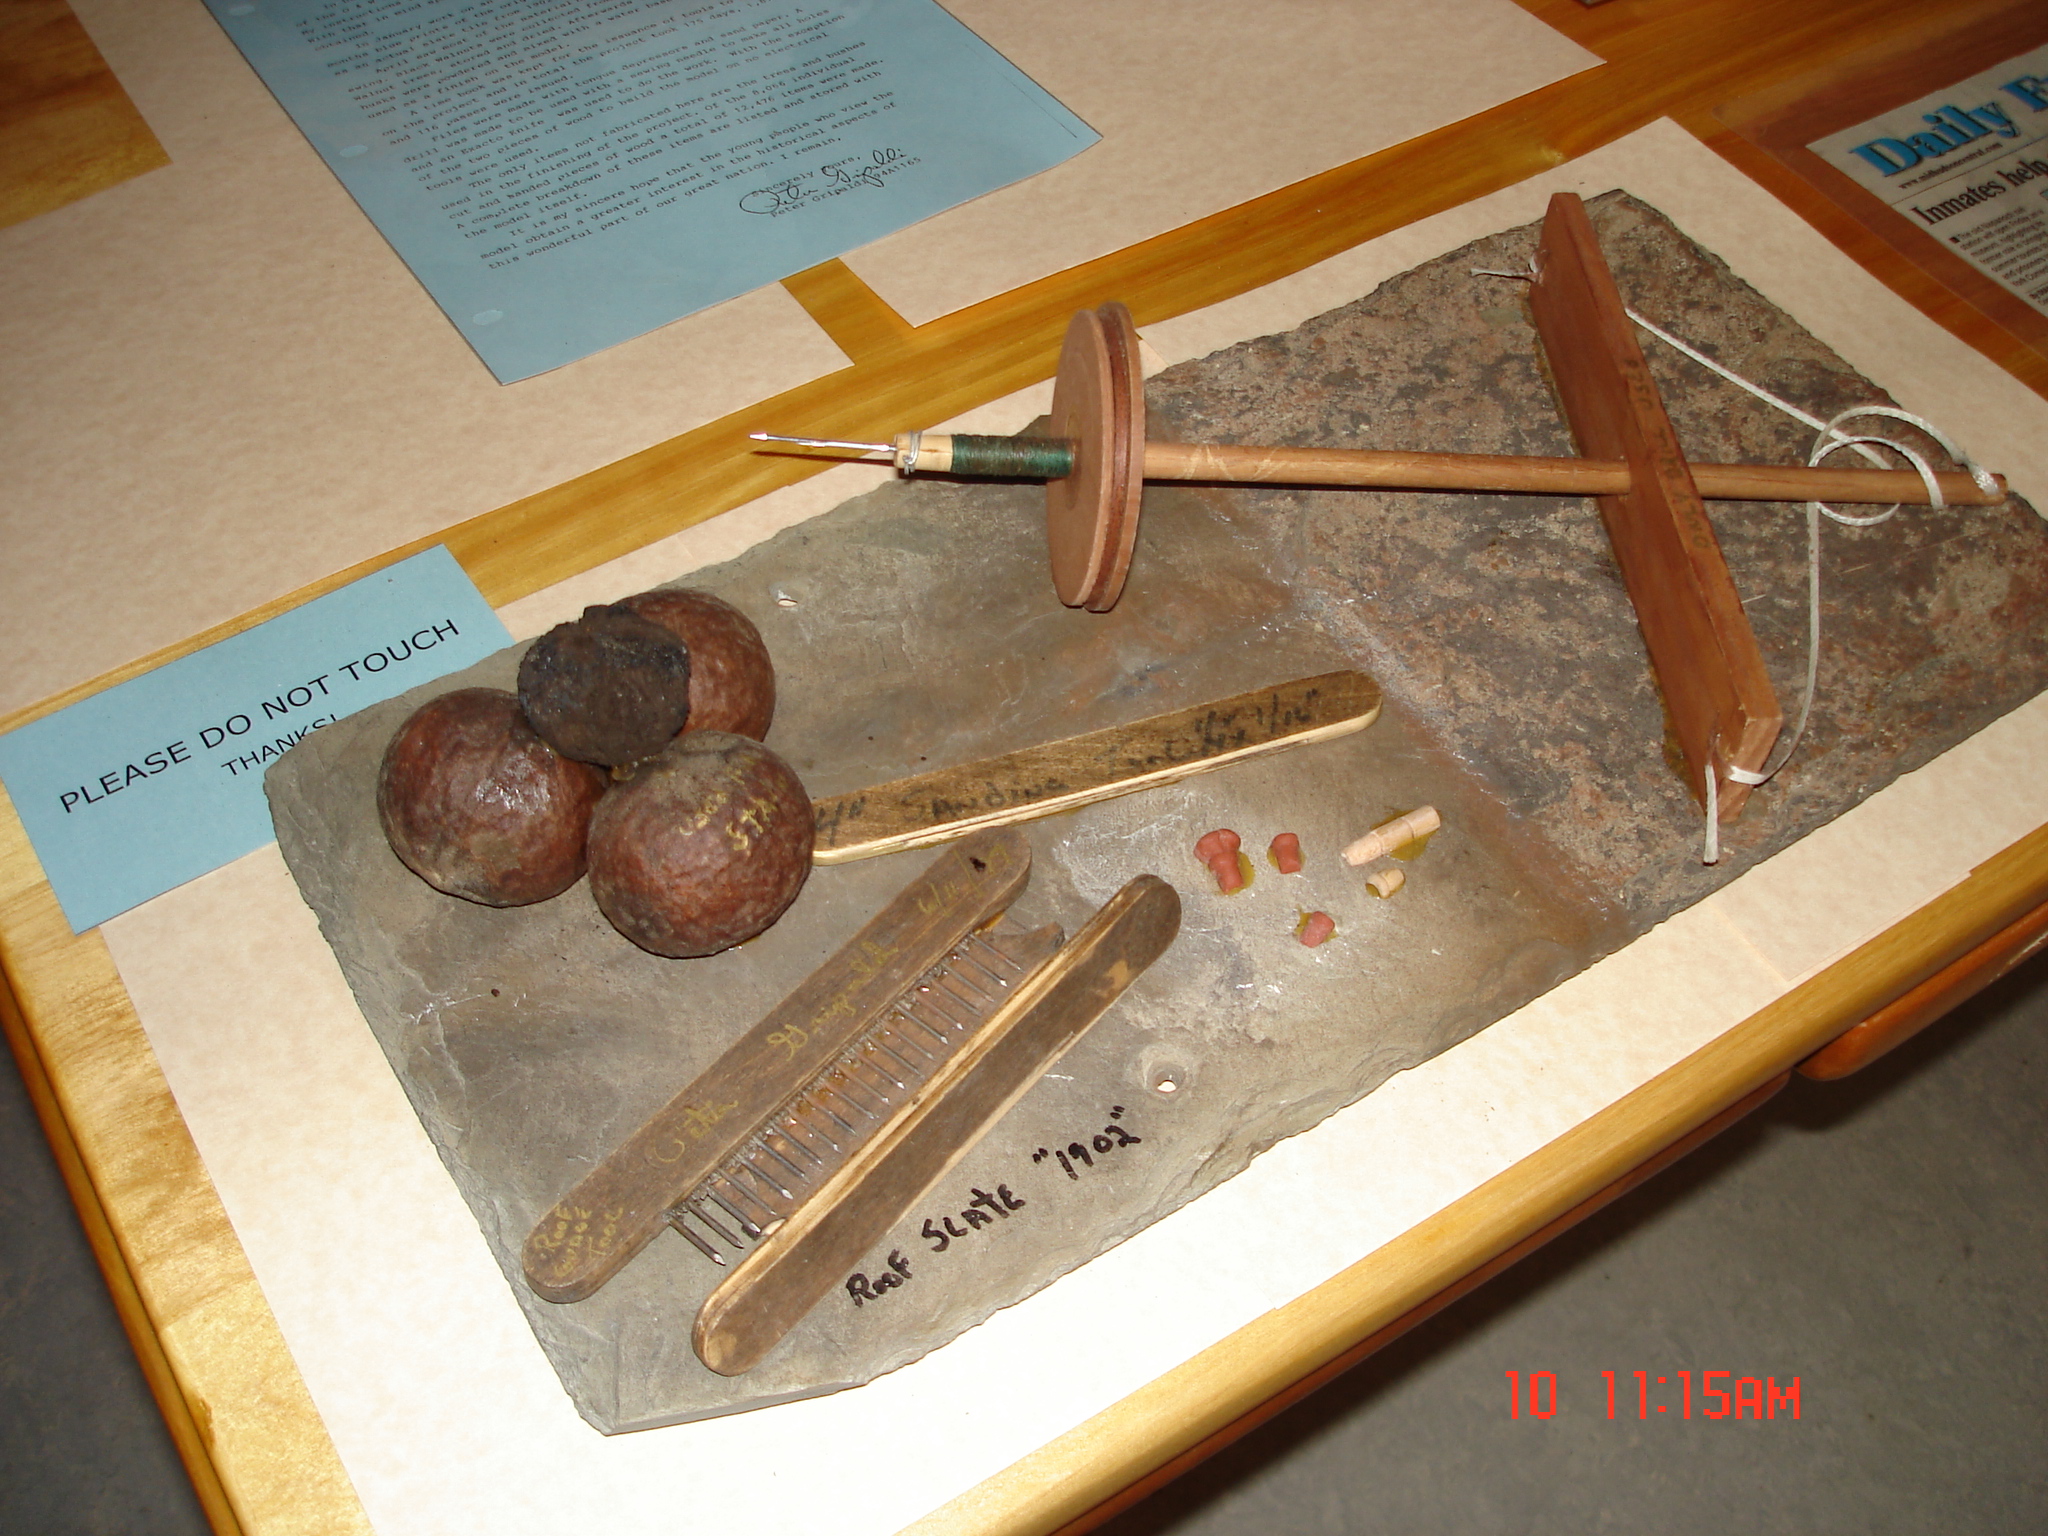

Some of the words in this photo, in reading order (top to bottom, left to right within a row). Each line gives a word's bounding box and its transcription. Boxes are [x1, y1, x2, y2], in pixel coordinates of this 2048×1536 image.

[410, 160, 434, 173] and
[439, 154, 455, 163] an
[556, 106, 579, 117] was
[583, 92, 613, 107] used
[616, 86, 633, 94] to
[637, 79, 653, 88] do
[656, 70, 679, 80] the
[683, 59, 717, 72] work.
[728, 45, 758, 57] With
[761, 36, 782, 46] the
[787, 14, 846, 38] exception
[417, 172, 432, 182] of
[439, 162, 462, 175] the
[467, 152, 491, 164] two
[496, 133, 540, 154] pieces
[544, 124, 559, 135] of
[564, 111, 594, 126] wood
[598, 105, 614, 113] to
[658, 80, 681, 91] the
[685, 67, 719, 83] model
[725, 61, 741, 69] on
[744, 55, 760, 63] no
[763, 31, 830, 57] electrical
[440, 195, 472, 210] used
[478, 189, 494, 198] in
[498, 178, 521, 190] the
[526, 150, 592, 180] finishing
[596, 141, 611, 152] of
[616, 132, 640, 144] the
[645, 111, 699, 134] project.
[703, 101, 720, 111] Of
[724, 94, 747, 104] the
[791, 56, 856, 83] individual
[448, 208, 472, 220] cut
[478, 197, 502, 210] and
[557, 160, 600, 182] pieces
[604, 151, 619, 162] of
[624, 137, 655, 153] wood
[672, 118, 709, 135] total
[713, 110, 728, 120] of
[780, 83, 815, 98] items
[818, 72, 847, 84] were
[850, 59, 884, 74] made.
[467, 177, 492, 189] The
[497, 162, 526, 178] only
[533, 147, 569, 165] items
[574, 136, 597, 148] not
[601, 106, 672, 137] fabricated
[674, 96, 705, 110] here
[710, 87, 732, 98] are
[735, 79, 758, 89] the
[762, 65, 797, 81] trees
[801, 56, 822, 68] and
[825, 40, 866, 59] bushes
[470, 200, 531, 225] complete
[534, 172, 602, 202] breakdown
[606, 163, 622, 174] of
[626, 148, 663, 166] these
[668, 132, 704, 149] items
[708, 123, 731, 134] are
[735, 106, 779, 125] listed
[782, 97, 805, 110] and
[809, 81, 850, 100] stored
[853, 70, 882, 84] with
[508, 227, 525, 237] It
[532, 219, 547, 229] is
[552, 211, 568, 221] my
[574, 189, 626, 213] sincere
[628, 176, 660, 191] hope
[665, 162, 695, 177] that
[699, 151, 722, 163] the
[726, 137, 764, 154] young
[813, 111, 836, 123] who
[839, 99, 868, 113] view
[872, 91, 894, 102] the
[823, 156, 861, 173] ours,
[1849, 102, 2021, 177] Daily
[425, 175, 463, 191] tools
[468, 162, 499, 176] were
[503, 147, 539, 163] used.
[463, 228, 488, 239] the
[492, 211, 532, 230] model
[538, 192, 588, 214] itself.
[479, 242, 519, 260] model
[524, 224, 571, 244] obtain
[589, 196, 641, 221] greater
[647, 171, 704, 198] interest
[709, 164, 725, 173] in
[728, 154, 752, 165] the
[755, 127, 827, 156] historical
[830, 109, 878, 130] aspects
[882, 100, 897, 111] of
[487, 255, 520, 270] this
[525, 228, 594, 257] wonderful
[599, 215, 630, 232] part
[634, 205, 650, 217] of
[655, 195, 678, 208] our
[683, 178, 720, 198] great
[724, 160, 774, 180] nation.
[1910, 180, 2007, 226] Inmates
[60, 741, 192, 813] PLEASE
[199, 714, 252, 749] DO
[261, 675, 340, 720] NOT
[339, 618, 460, 682] TOUCH
